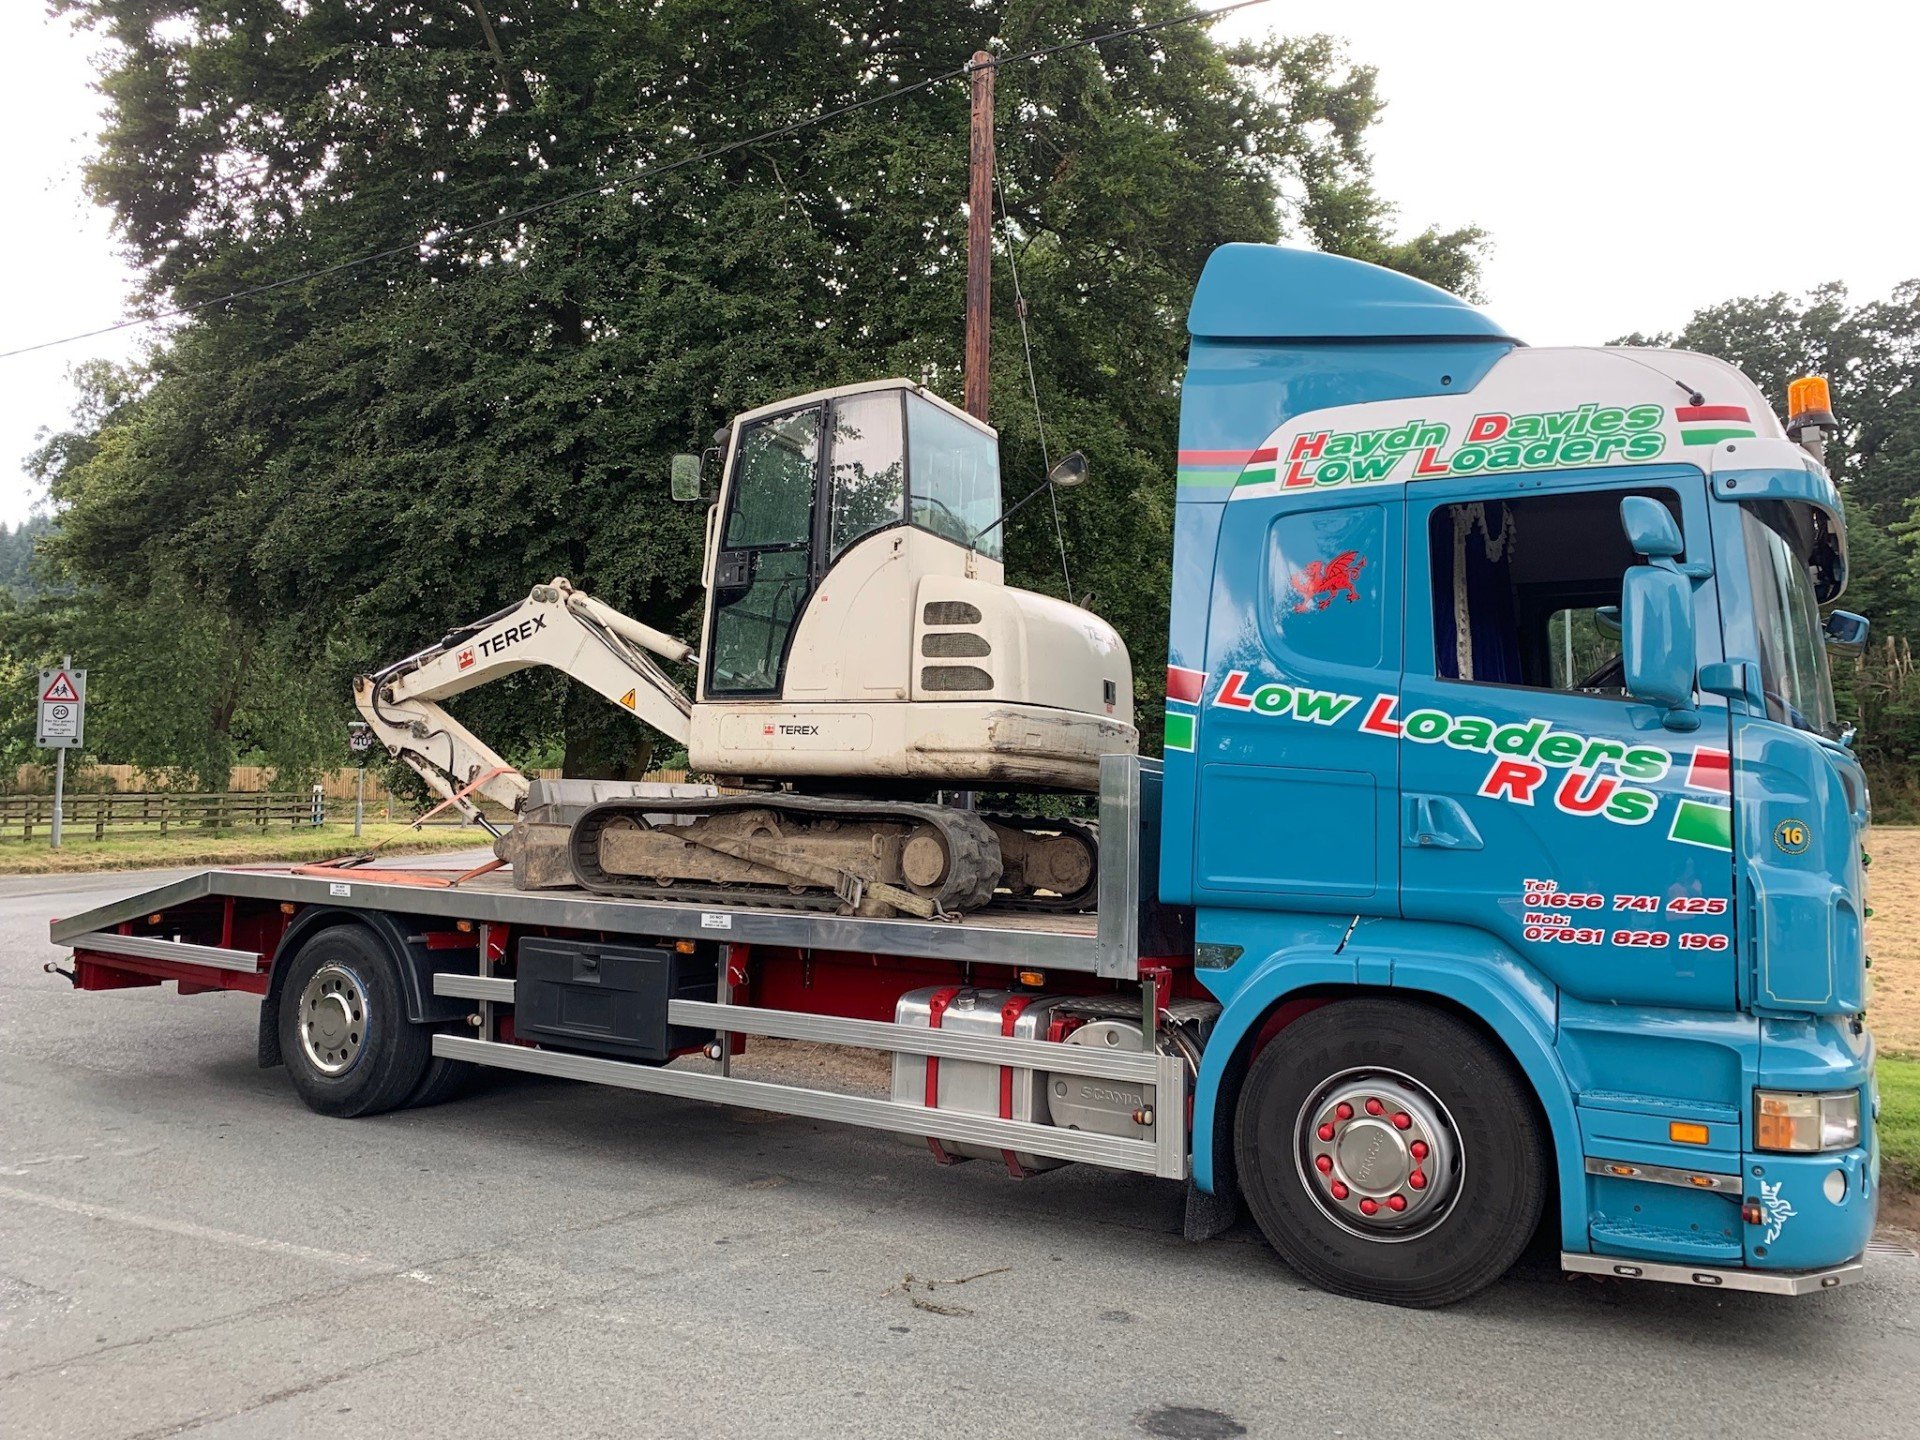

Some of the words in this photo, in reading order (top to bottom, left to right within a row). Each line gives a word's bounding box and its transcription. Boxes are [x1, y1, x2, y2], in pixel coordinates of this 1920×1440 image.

[1287, 420, 1450, 462] Haydn
[1466, 403, 1663, 445] Davies
[1283, 454, 1403, 488] Low
[1415, 432, 1664, 475] Loaders
[479, 613, 547, 657] TEREX
[779, 725, 819, 736] TEREX
[1214, 672, 1360, 724] Low
[1360, 695, 1671, 783] Loaders
[353, 735, 368, 746] 40
[1480, 760, 1546, 806] R
[1555, 772, 1658, 826] Us
[1781, 827, 1804, 845] 16
[1524, 879, 1557, 892] Tel:
[1523, 893, 1604, 909] 01656
[1613, 895, 1659, 912] 741
[1667, 898, 1728, 914] 425
[1524, 913, 1571, 926] Mob:
[1523, 926, 1604, 944] 07831
[1612, 930, 1669, 948] 828
[1678, 934, 1728, 951] 196
[1080, 1086, 1143, 1108] SCANIA
